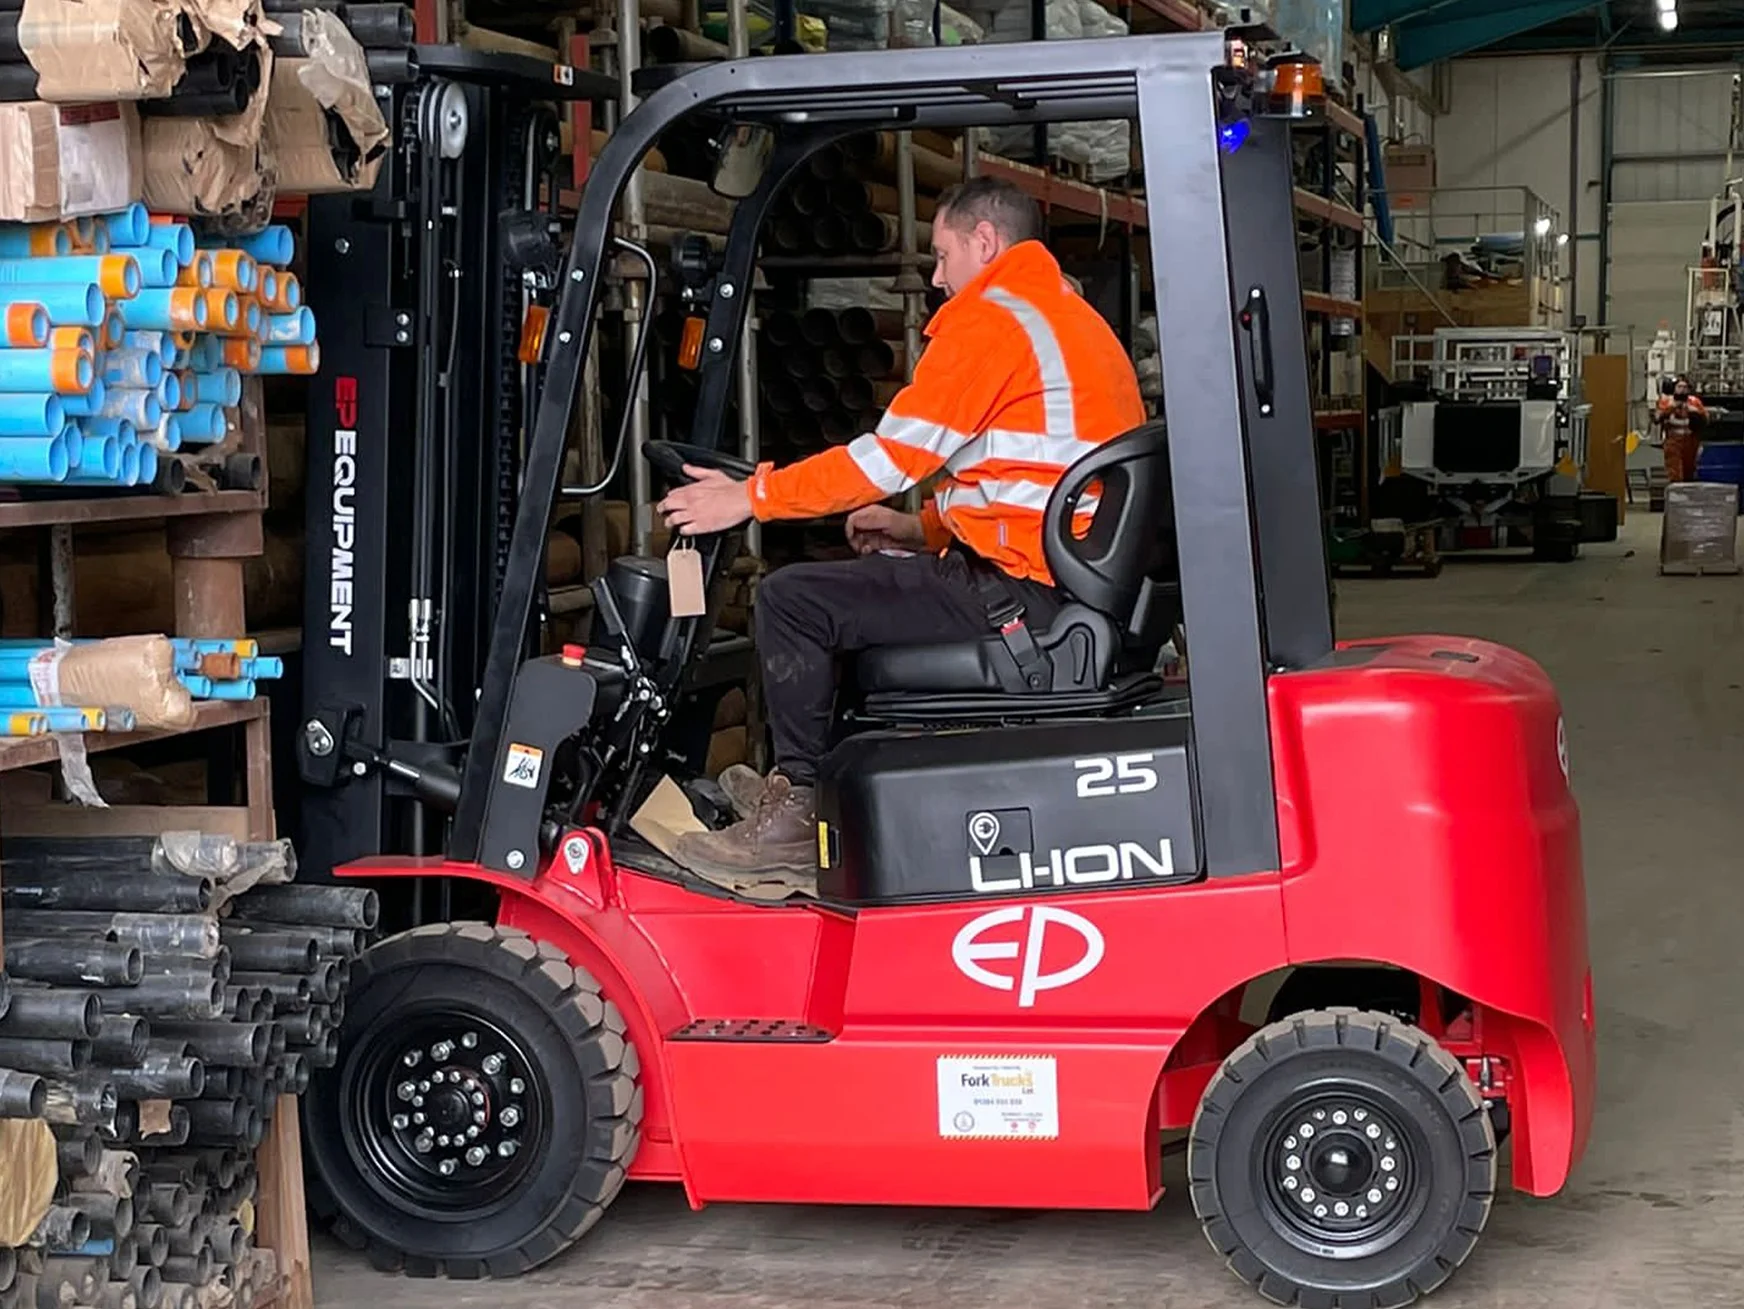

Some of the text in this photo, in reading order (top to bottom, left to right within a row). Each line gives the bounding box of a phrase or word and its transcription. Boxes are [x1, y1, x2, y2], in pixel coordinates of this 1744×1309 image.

[330, 376, 357, 655] EP EQUIPMENT
[1073, 753, 1158, 797] 25
[970, 838, 1174, 892] LI-ION
[952, 906, 1105, 1007] EP
